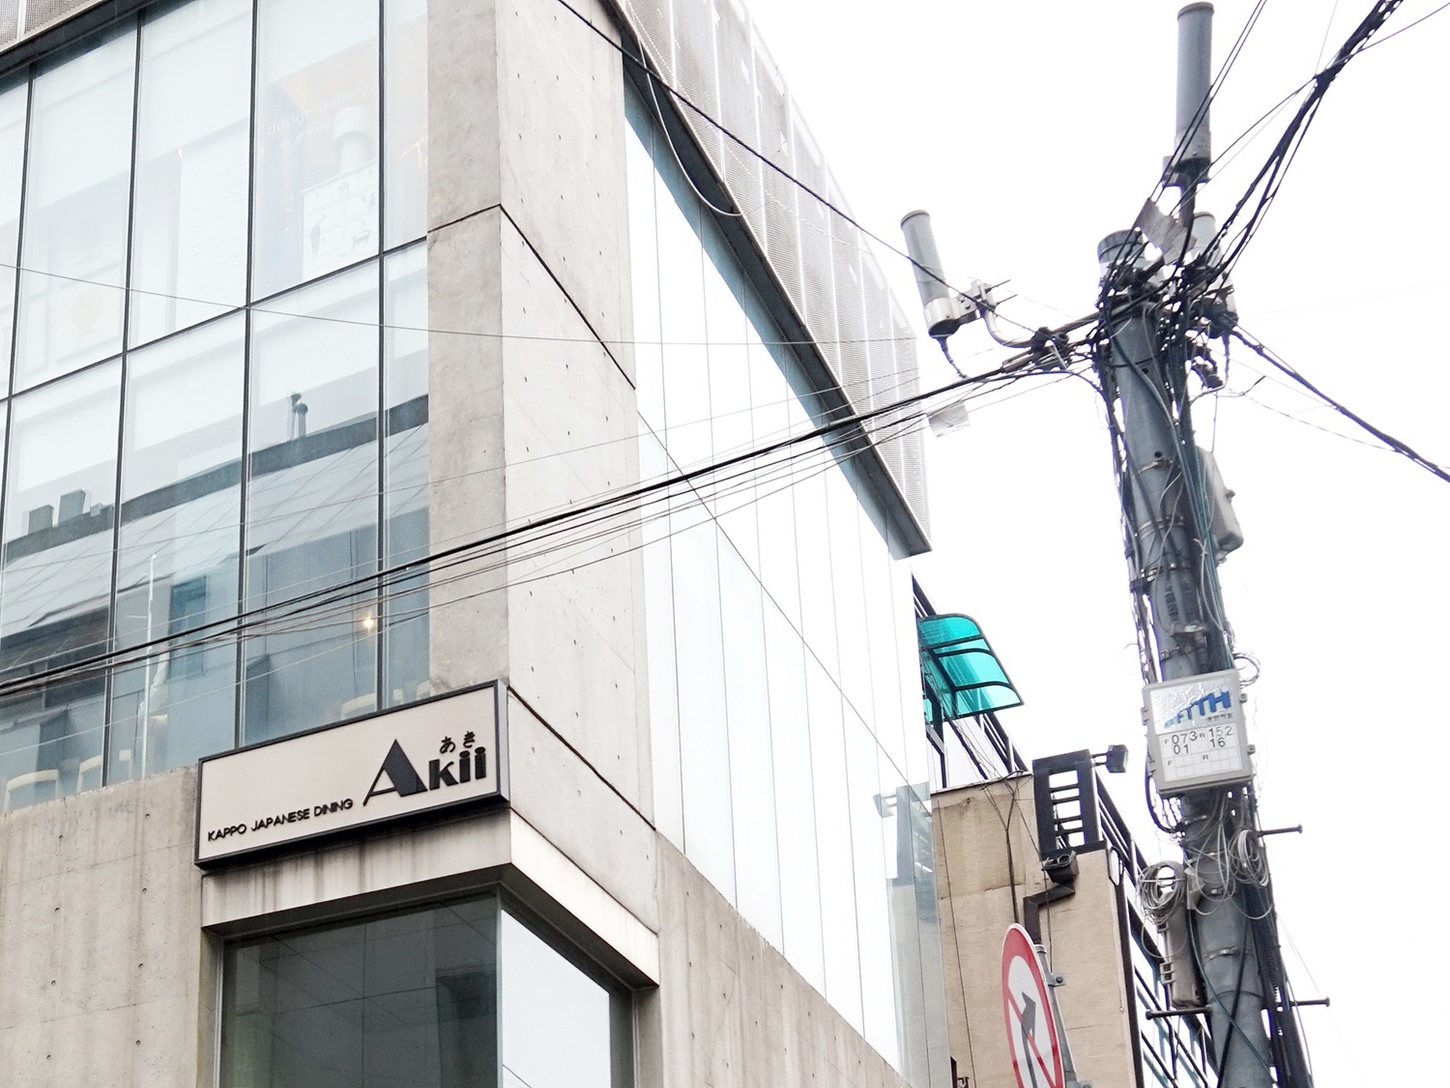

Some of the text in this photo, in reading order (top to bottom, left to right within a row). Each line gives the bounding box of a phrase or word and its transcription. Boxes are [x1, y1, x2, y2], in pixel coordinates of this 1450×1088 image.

[439, 730, 476, 753] あき
[1171, 731, 1198, 745] 073
[1208, 726, 1234, 738] 152
[1173, 737, 1226, 756] 01 16
[363, 738, 487, 806] Akii
[207, 798, 354, 842] KAPPO JAPANESE DINING
